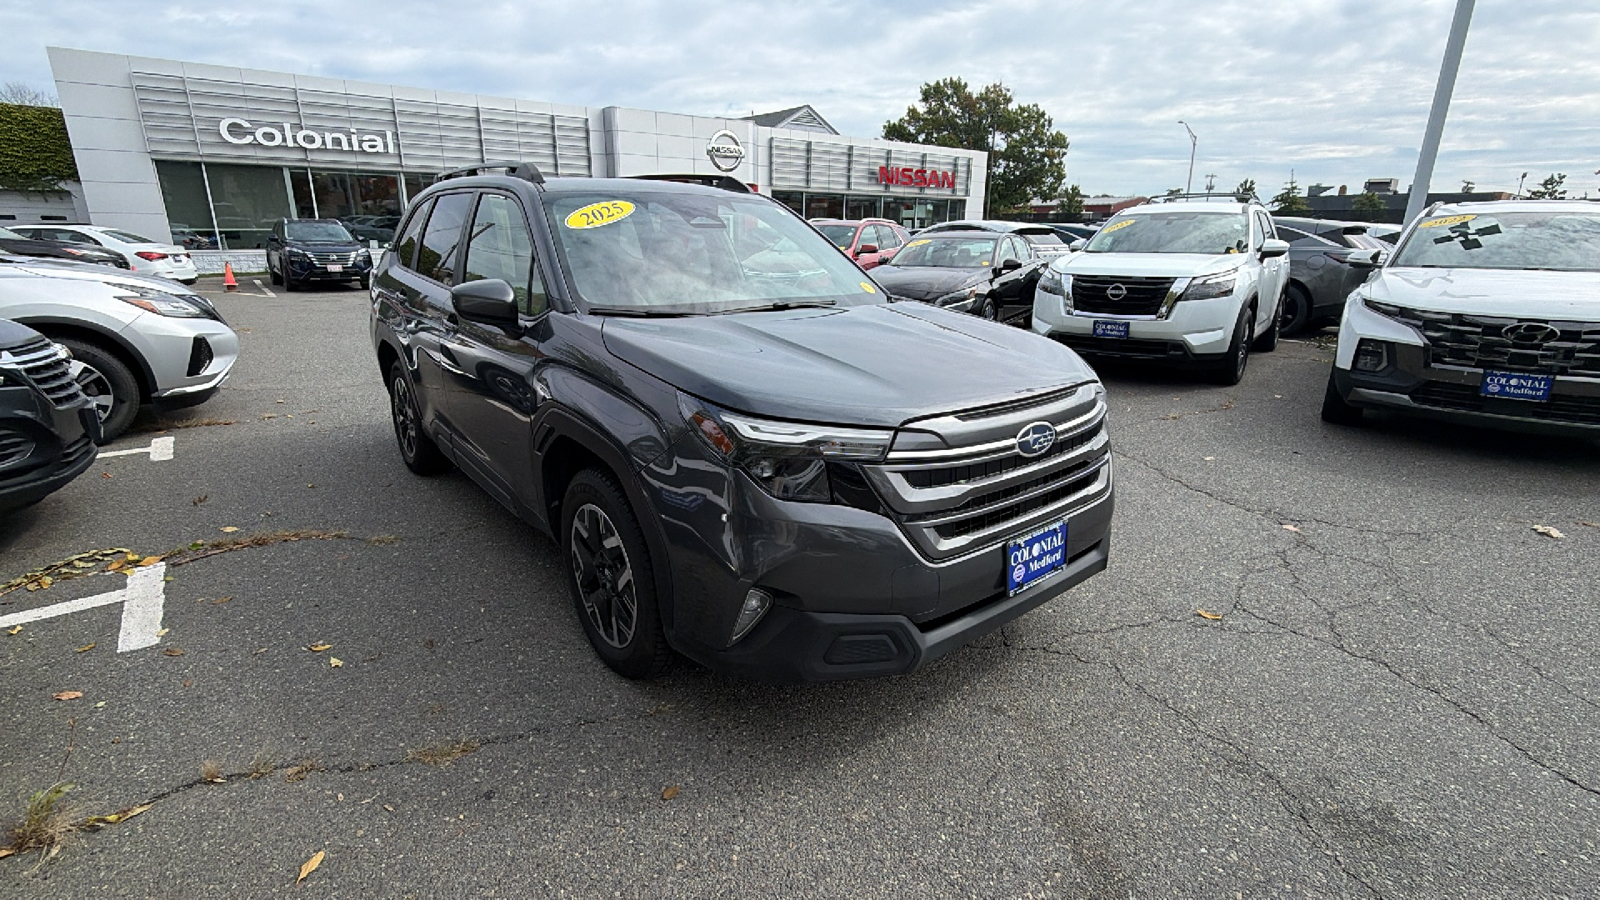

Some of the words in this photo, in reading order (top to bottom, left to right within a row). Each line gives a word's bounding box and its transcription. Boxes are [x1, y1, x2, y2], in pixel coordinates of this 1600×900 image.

[219, 117, 394, 153] Colonial
[711, 146, 742, 156] NISSAN
[879, 166, 955, 188] NISSAN
[580, 203, 624, 225] 2025
[1486, 376, 1548, 389] COLONIAL
[1504, 386, 1544, 396] Medford
[1011, 532, 1064, 566] COLONIAL
[1028, 549, 1062, 574] Medford
